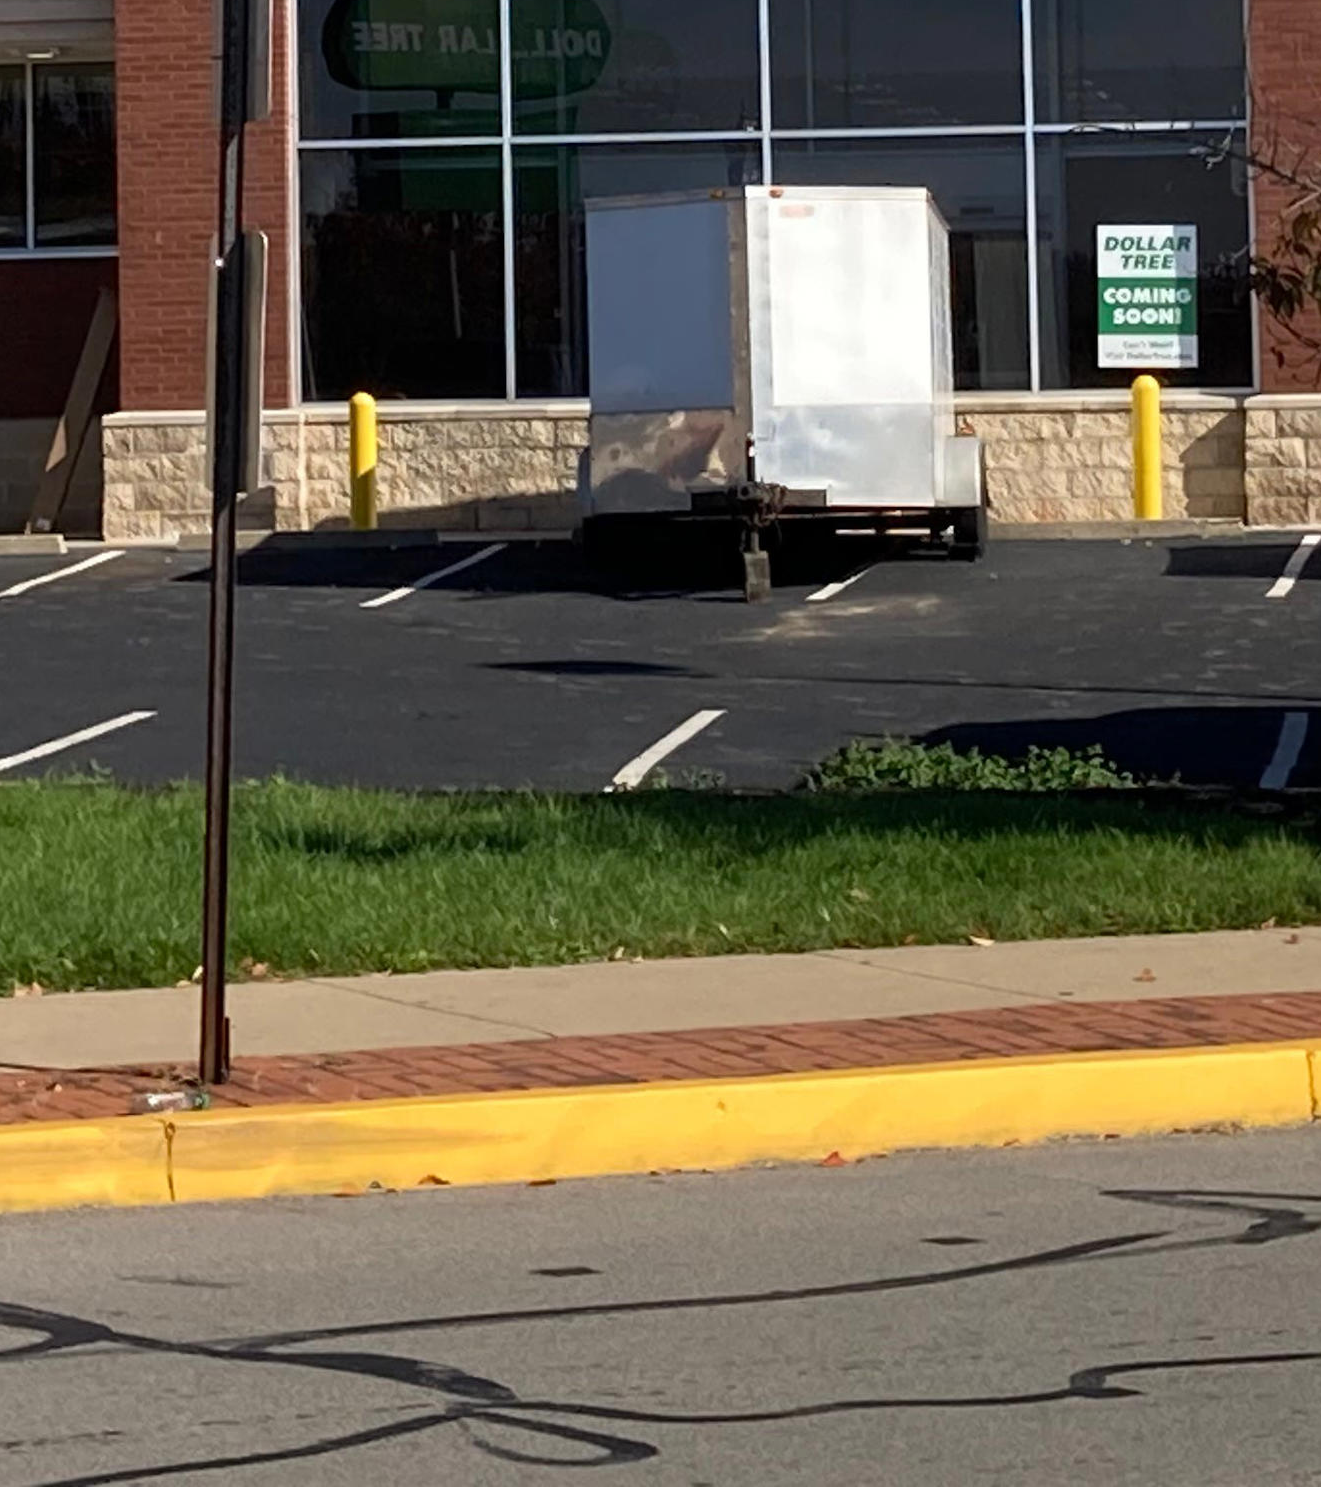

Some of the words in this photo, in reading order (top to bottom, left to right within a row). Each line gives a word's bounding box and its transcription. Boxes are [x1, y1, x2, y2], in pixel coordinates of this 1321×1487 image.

[1103, 236, 1191, 252] DOLLAR
[1121, 254, 1174, 270] TREE
[1103, 287, 1192, 304] COMING
[1112, 307, 1182, 324] SOON!
